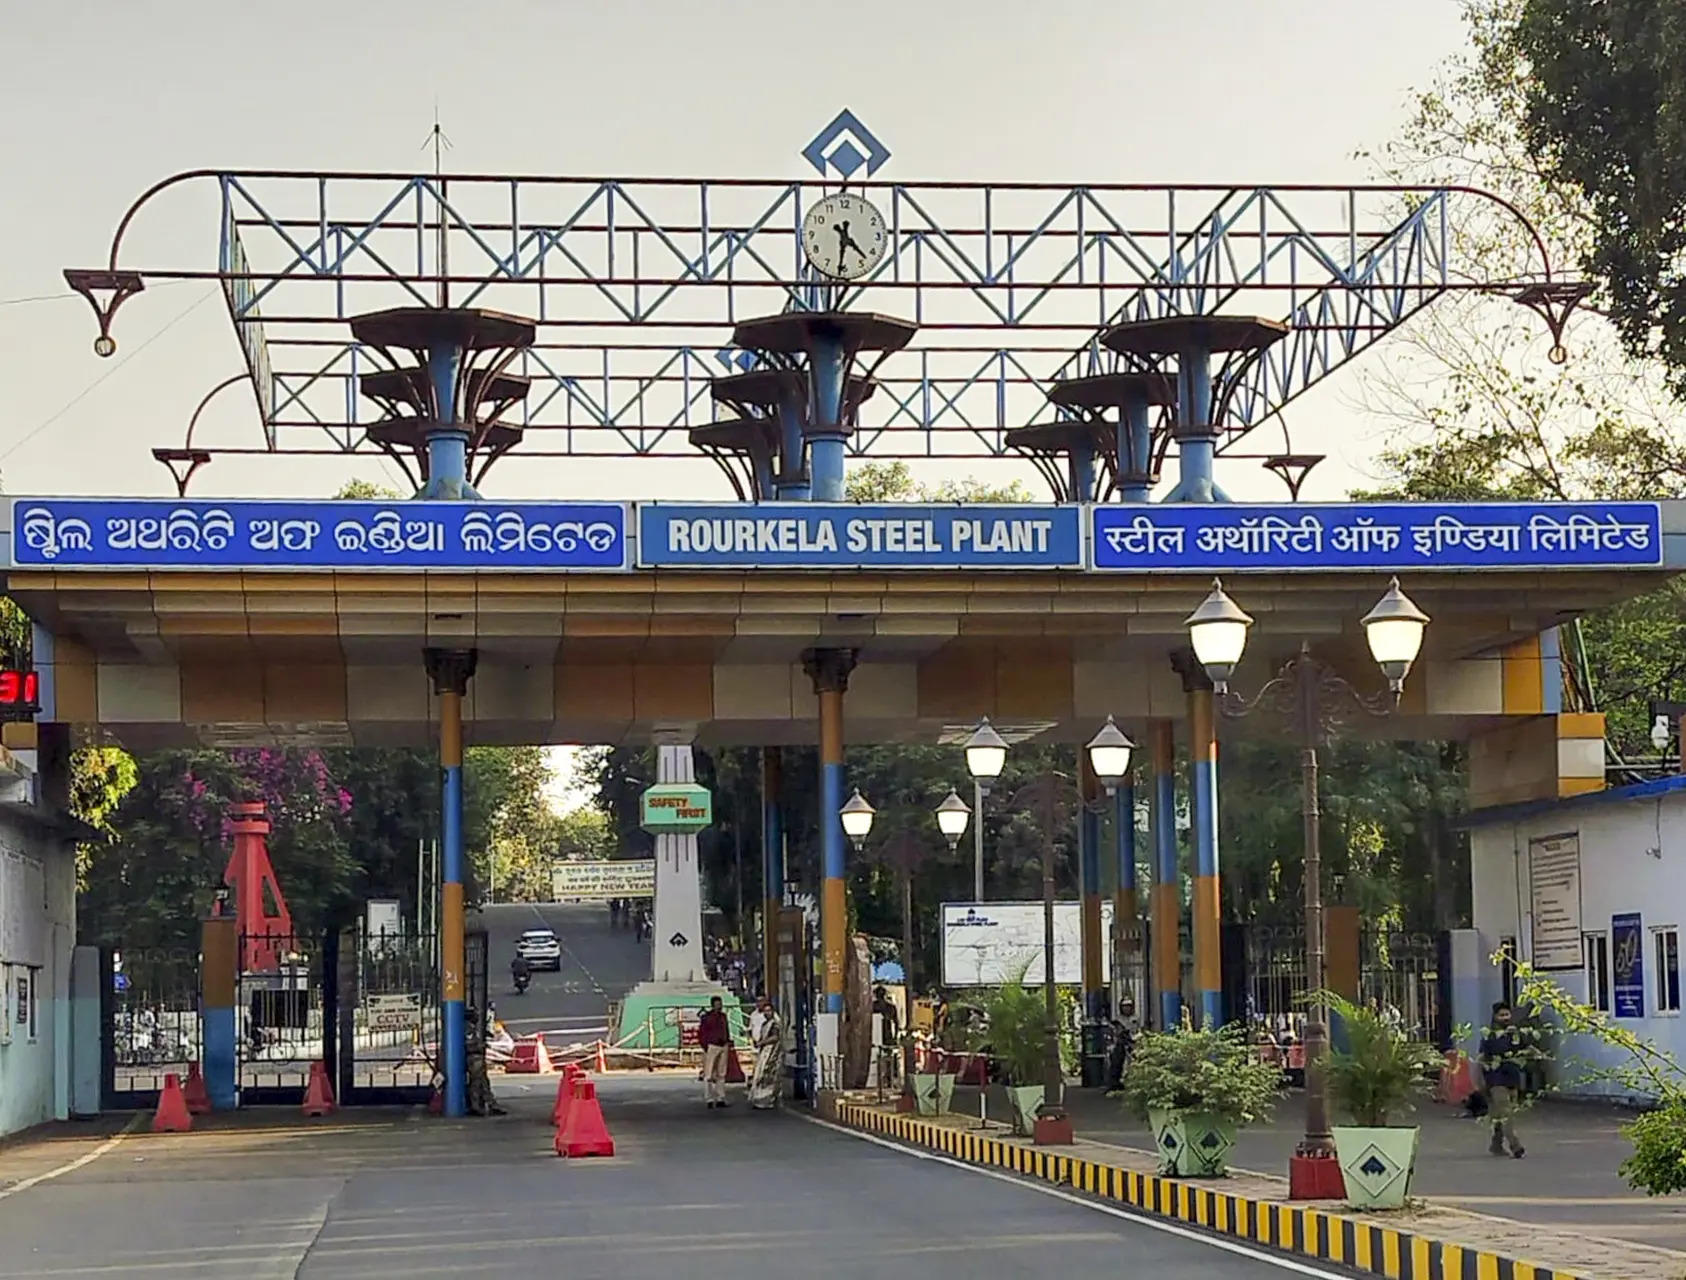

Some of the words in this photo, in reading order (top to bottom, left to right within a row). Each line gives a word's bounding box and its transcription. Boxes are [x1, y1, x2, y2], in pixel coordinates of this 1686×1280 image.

[825, 204, 834, 214] 11
[840, 199, 850, 209] 12
[859, 204, 864, 214] 1
[813, 216, 825, 225] 10
[870, 216, 877, 226] 2
[808, 230, 815, 240] 9
[813, 244, 819, 254] 8
[869, 247, 876, 255] 4
[824, 258, 831, 267] 7
[858, 259, 864, 268] 5
[107, 509, 235, 552] ଅଥରିଟି
[249, 520, 321, 550] ଅଫ
[334, 511, 444, 554] ଇଣ୍ଡିଆ
[460, 511, 616, 553] ଲିମିଟେଡ
[668, 519, 838, 552] ROURKELA
[846, 519, 942, 552] STEEL
[951, 520, 1052, 552] PLANT
[1103, 516, 1185, 553] स्टील
[1196, 515, 1324, 553] अथॉरिटी
[1330, 517, 1402, 552] ऑफ
[1410, 515, 1521, 557] इण्डिया
[1527, 513, 1650, 551] लिमिटेड
[648, 798, 688, 808] SAFETY
[376, 1013, 409, 1023] CCTV
